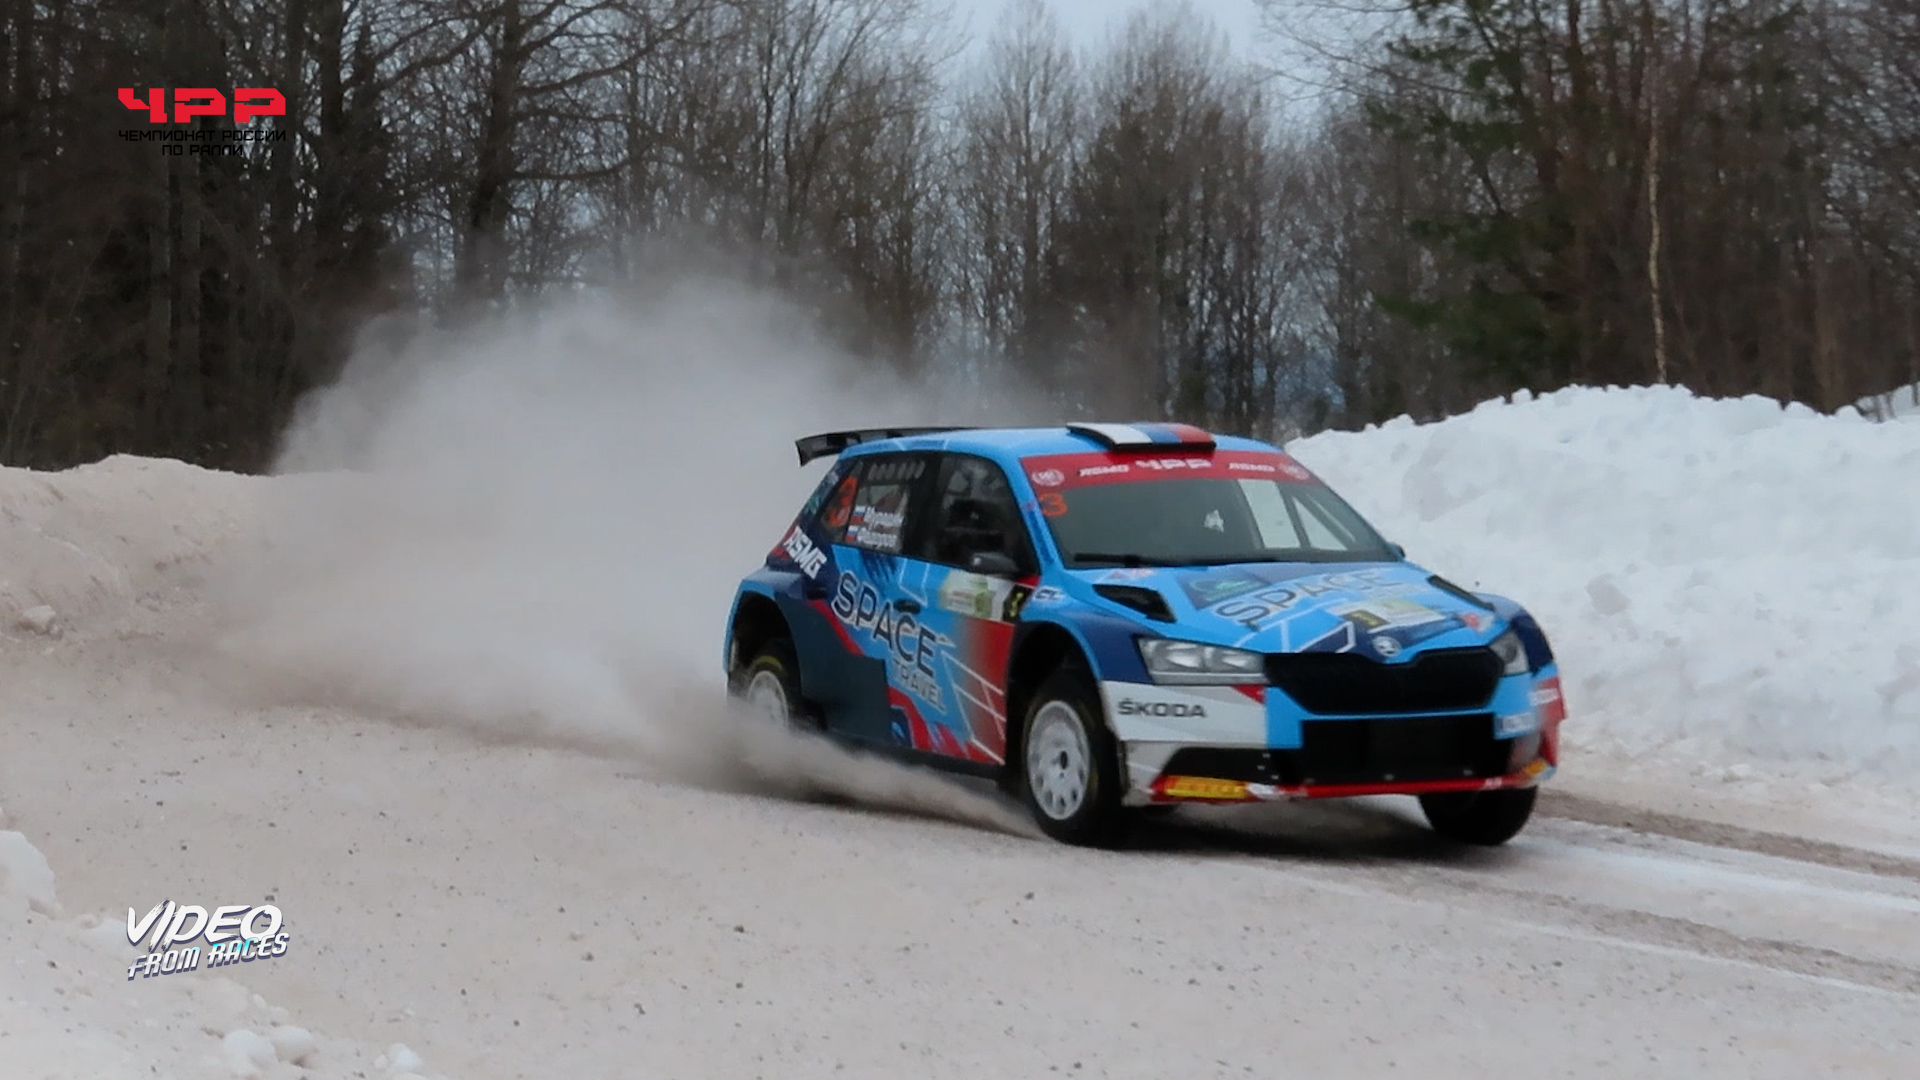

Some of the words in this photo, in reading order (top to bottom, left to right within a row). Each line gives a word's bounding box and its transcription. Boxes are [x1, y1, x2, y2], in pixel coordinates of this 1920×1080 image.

[1040, 493, 1067, 517] 3
[831, 571, 937, 679] SPACE
[1214, 571, 1403, 633] SPACE
